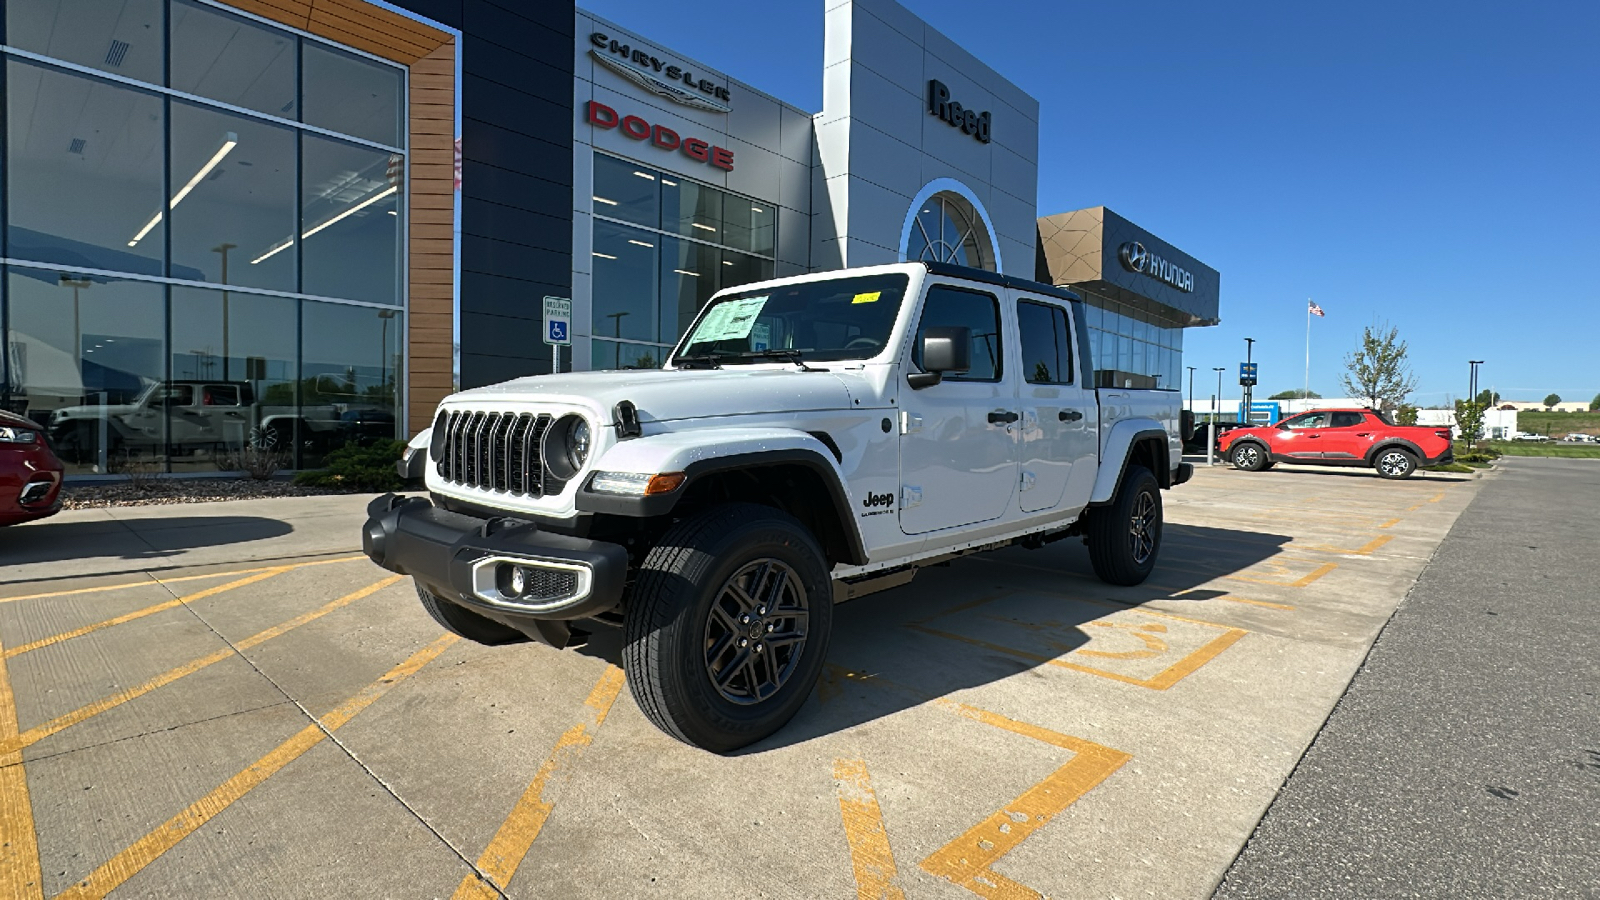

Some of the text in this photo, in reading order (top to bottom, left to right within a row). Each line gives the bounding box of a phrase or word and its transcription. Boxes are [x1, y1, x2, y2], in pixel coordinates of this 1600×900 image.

[590, 32, 730, 101] CHRYSLER
[587, 100, 734, 172] DODGE
[929, 79, 991, 144] Reed
[1149, 253, 1194, 292] HYUNDAI
[546, 309, 569, 318] PARKING
[863, 491, 894, 508] Jeep
